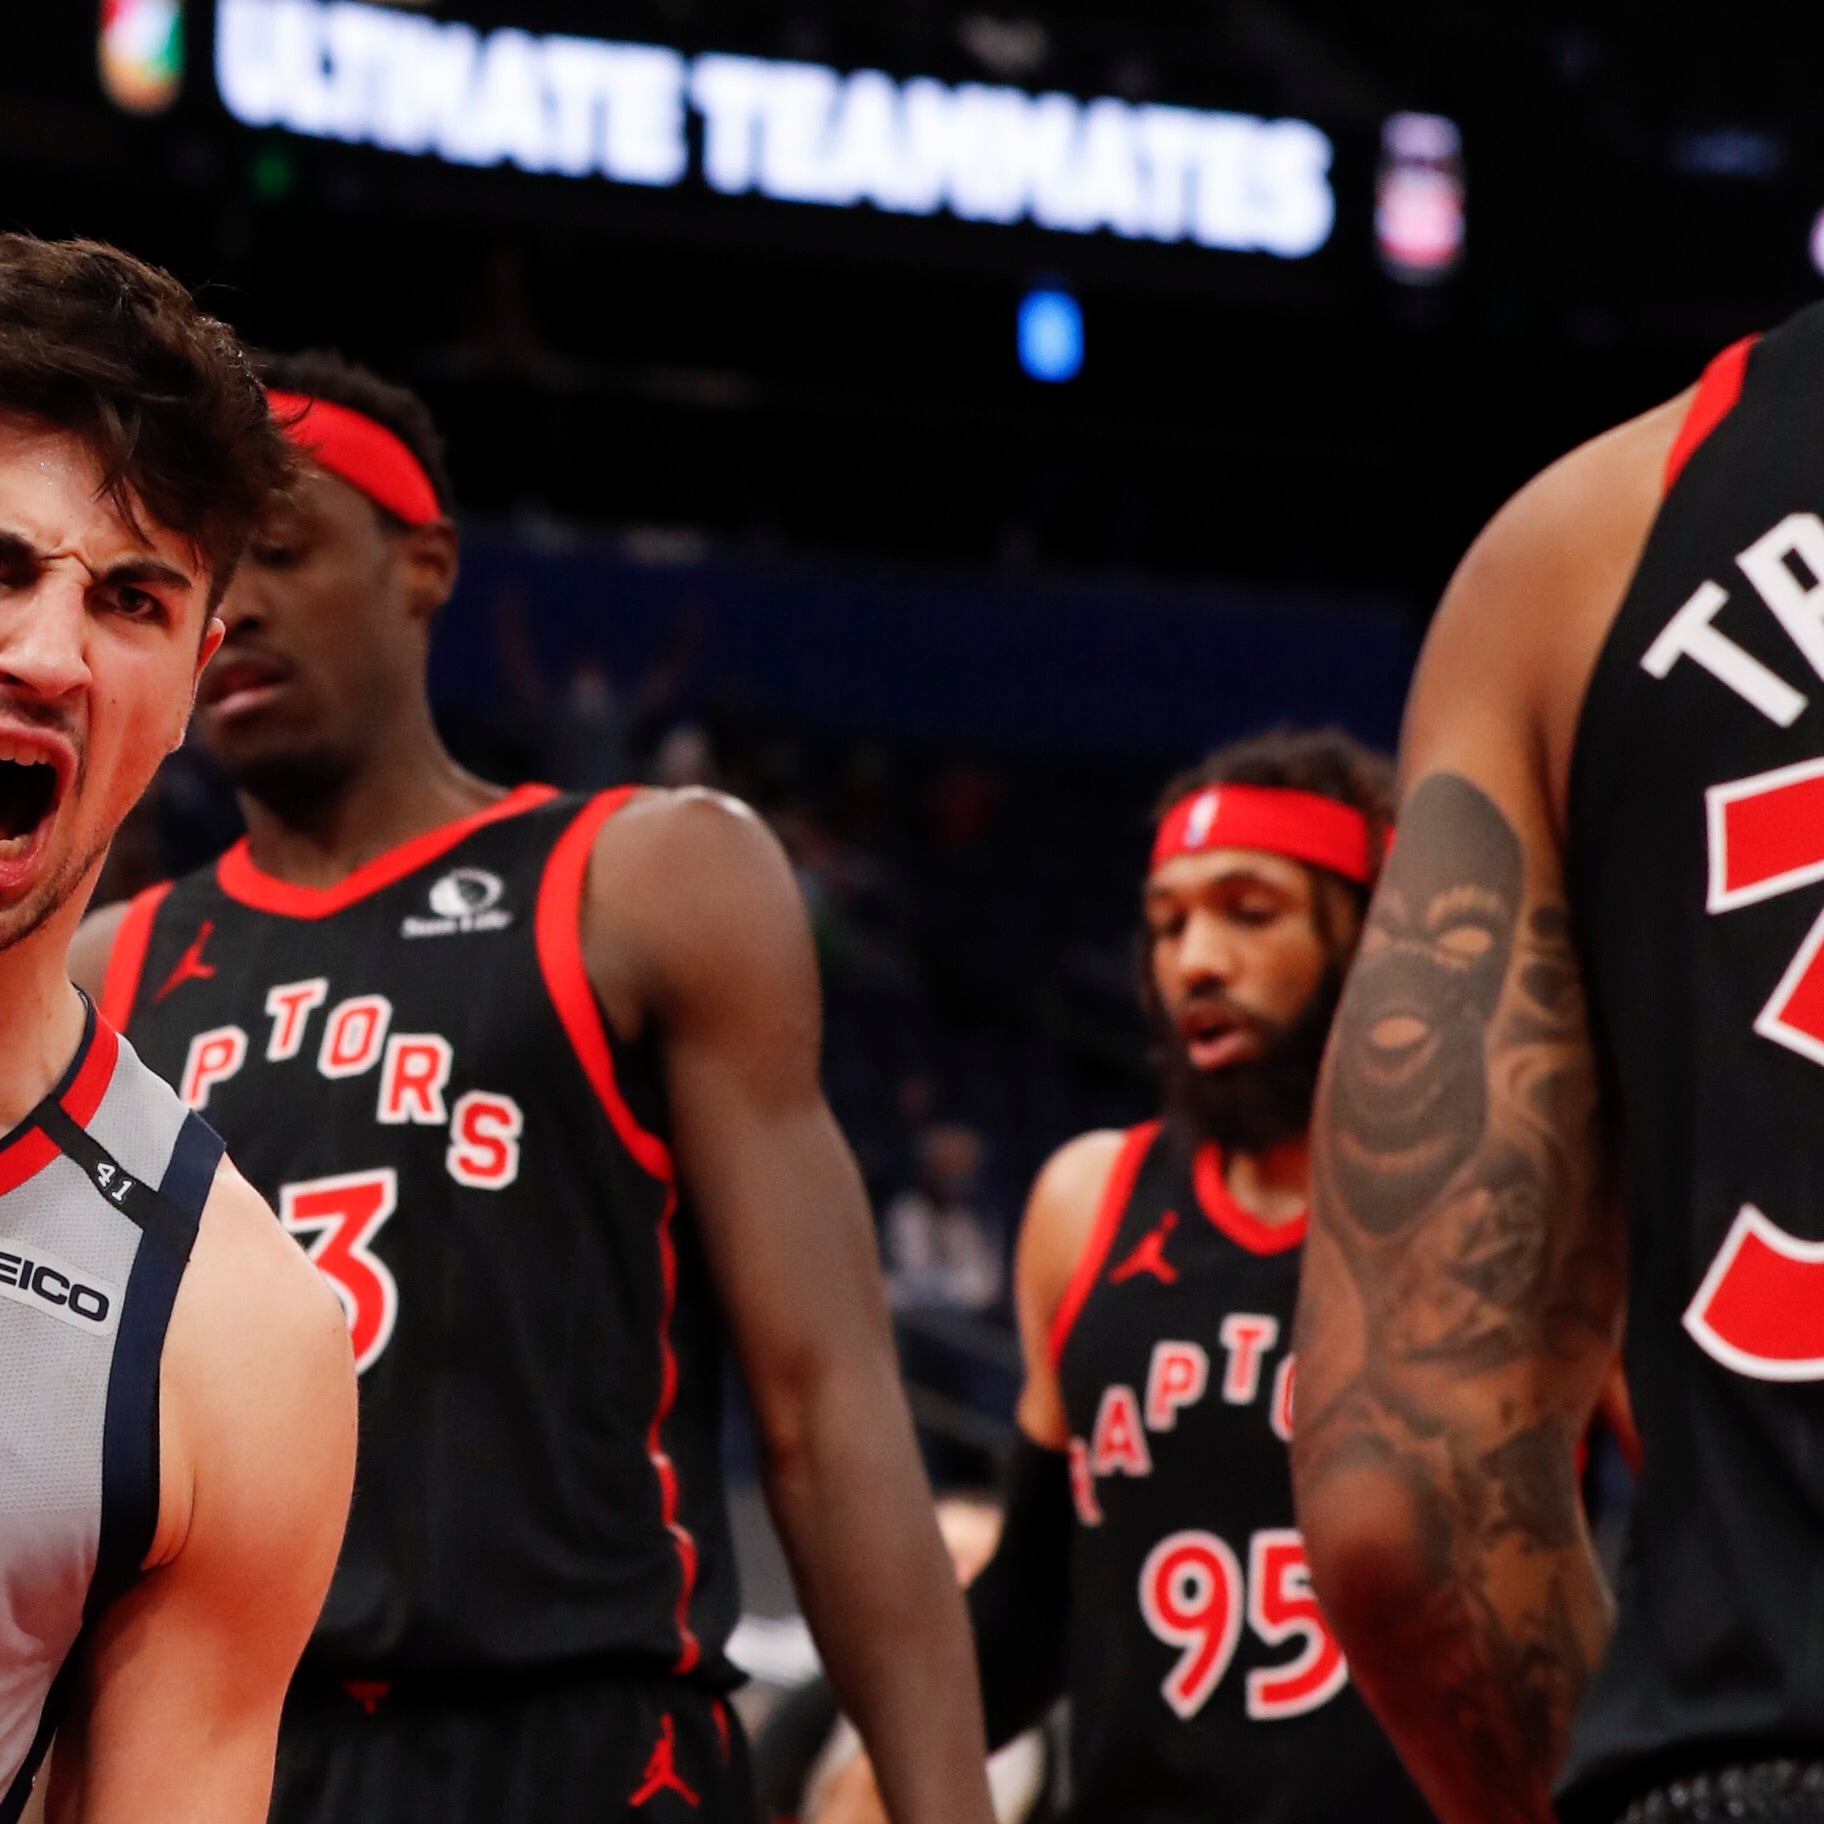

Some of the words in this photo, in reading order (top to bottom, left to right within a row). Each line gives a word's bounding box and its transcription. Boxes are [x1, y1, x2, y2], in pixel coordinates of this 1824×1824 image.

[690, 54, 1333, 255] TEAMMATES
[97, 1162, 132, 1201] 41
[1138, 1528, 1351, 1721] 95
